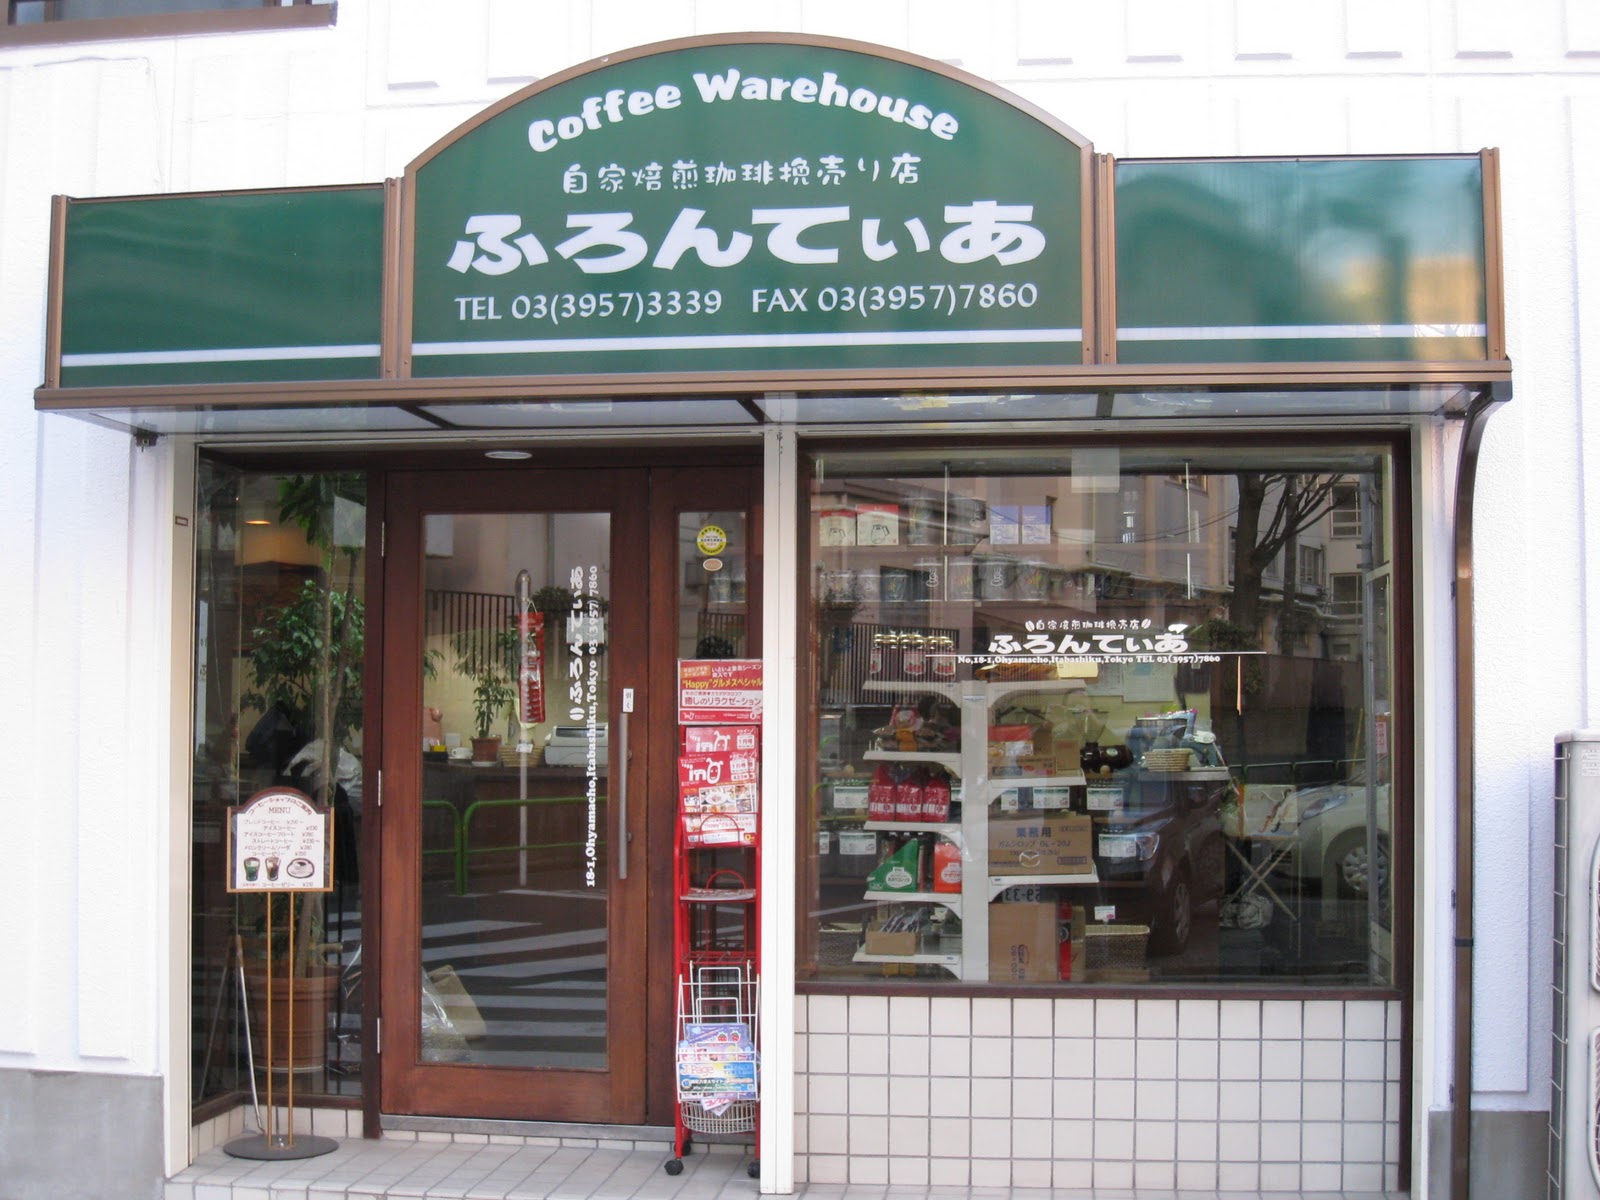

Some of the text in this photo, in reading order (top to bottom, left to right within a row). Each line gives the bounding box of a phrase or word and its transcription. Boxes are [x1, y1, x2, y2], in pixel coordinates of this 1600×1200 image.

[528, 68, 958, 152] Coffee Warehouse
[447, 200, 1046, 275] ふろんてぃあ
[455, 283, 1038, 325] TEL 03(3957)3339 FAX 03(3957)7860
[988, 633, 1189, 654] ふろんてぃあ
[1136, 655, 1155, 663] TEL
